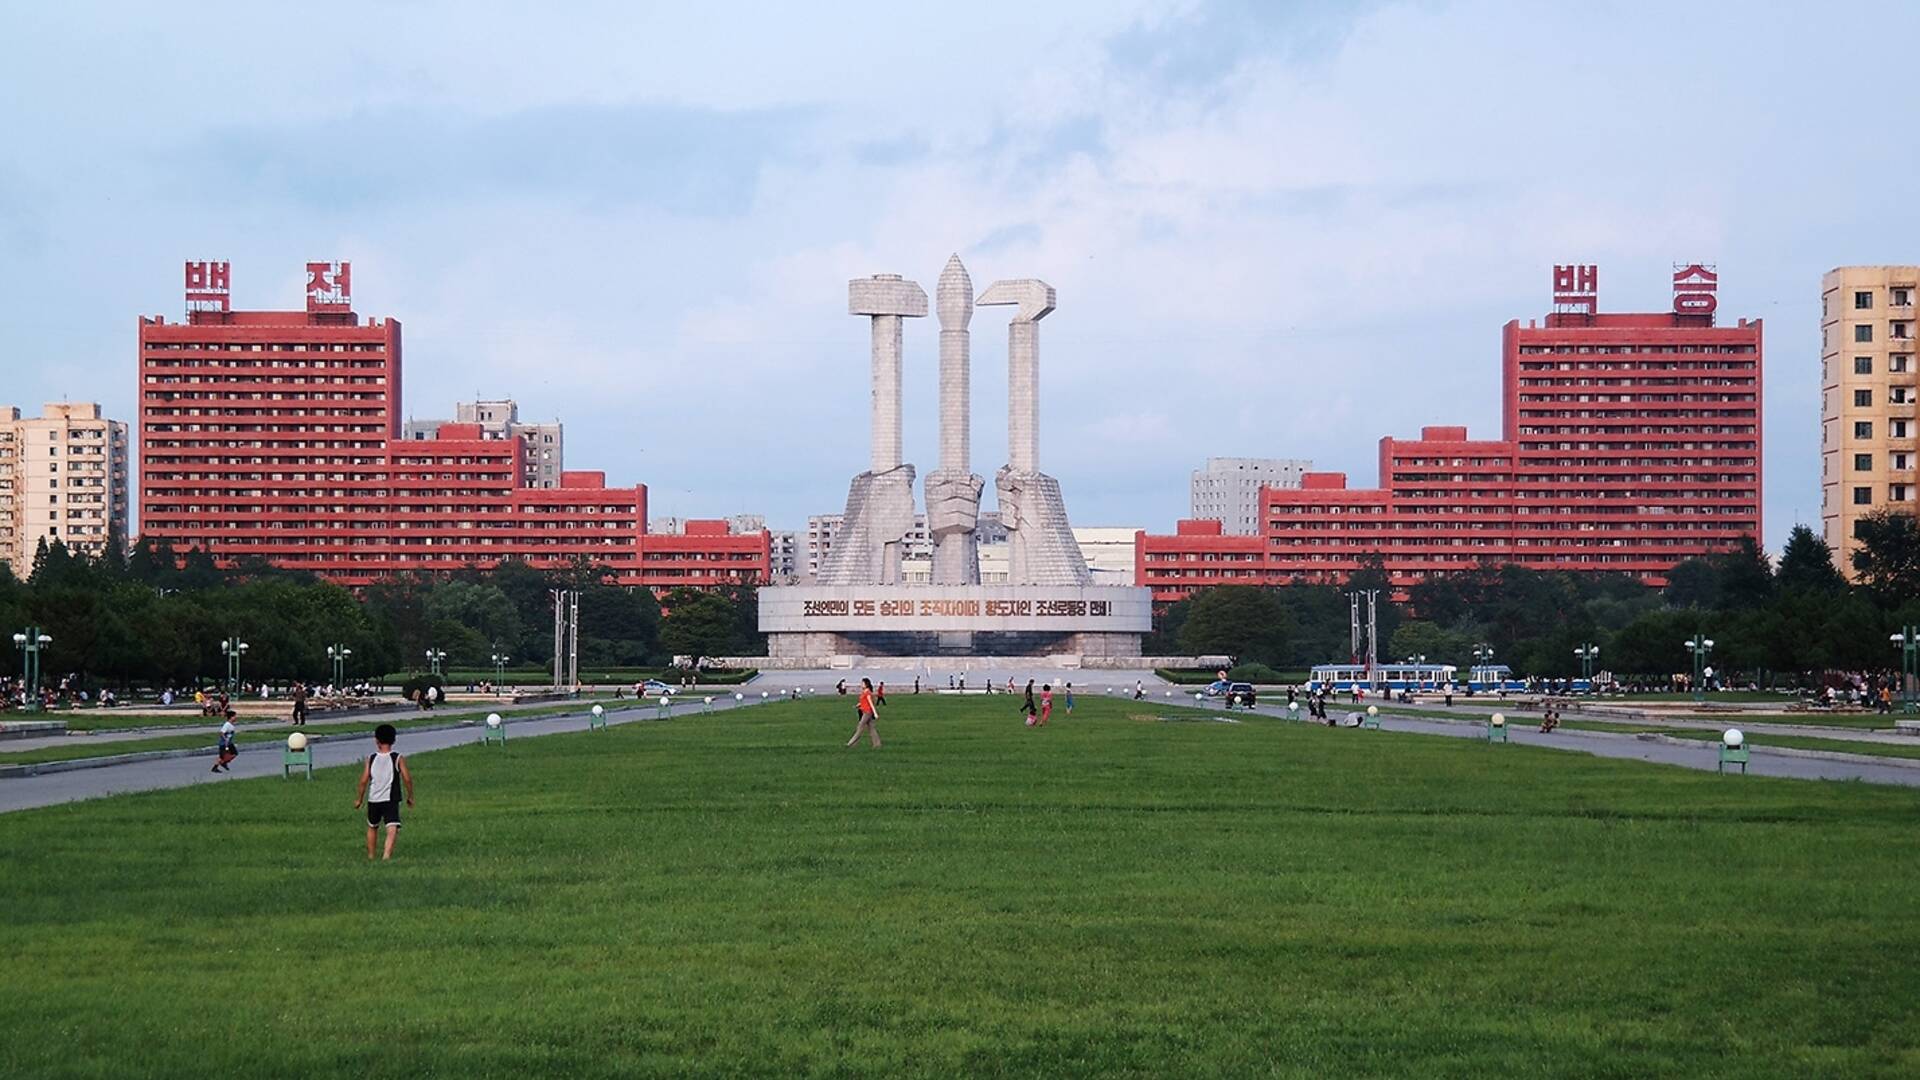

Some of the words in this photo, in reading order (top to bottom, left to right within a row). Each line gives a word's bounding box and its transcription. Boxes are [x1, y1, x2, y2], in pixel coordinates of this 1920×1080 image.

[186, 262, 230, 311] 백
[307, 263, 351, 312] 전
[1554, 265, 1597, 314] 백
[1673, 265, 1717, 314] 승
[853, 600, 875, 616] 모든
[880, 600, 914, 616] 승리의
[920, 600, 979, 616] 조직자이며
[985, 600, 1031, 616] 향도자인
[1036, 600, 1087, 616] 조선로동당
